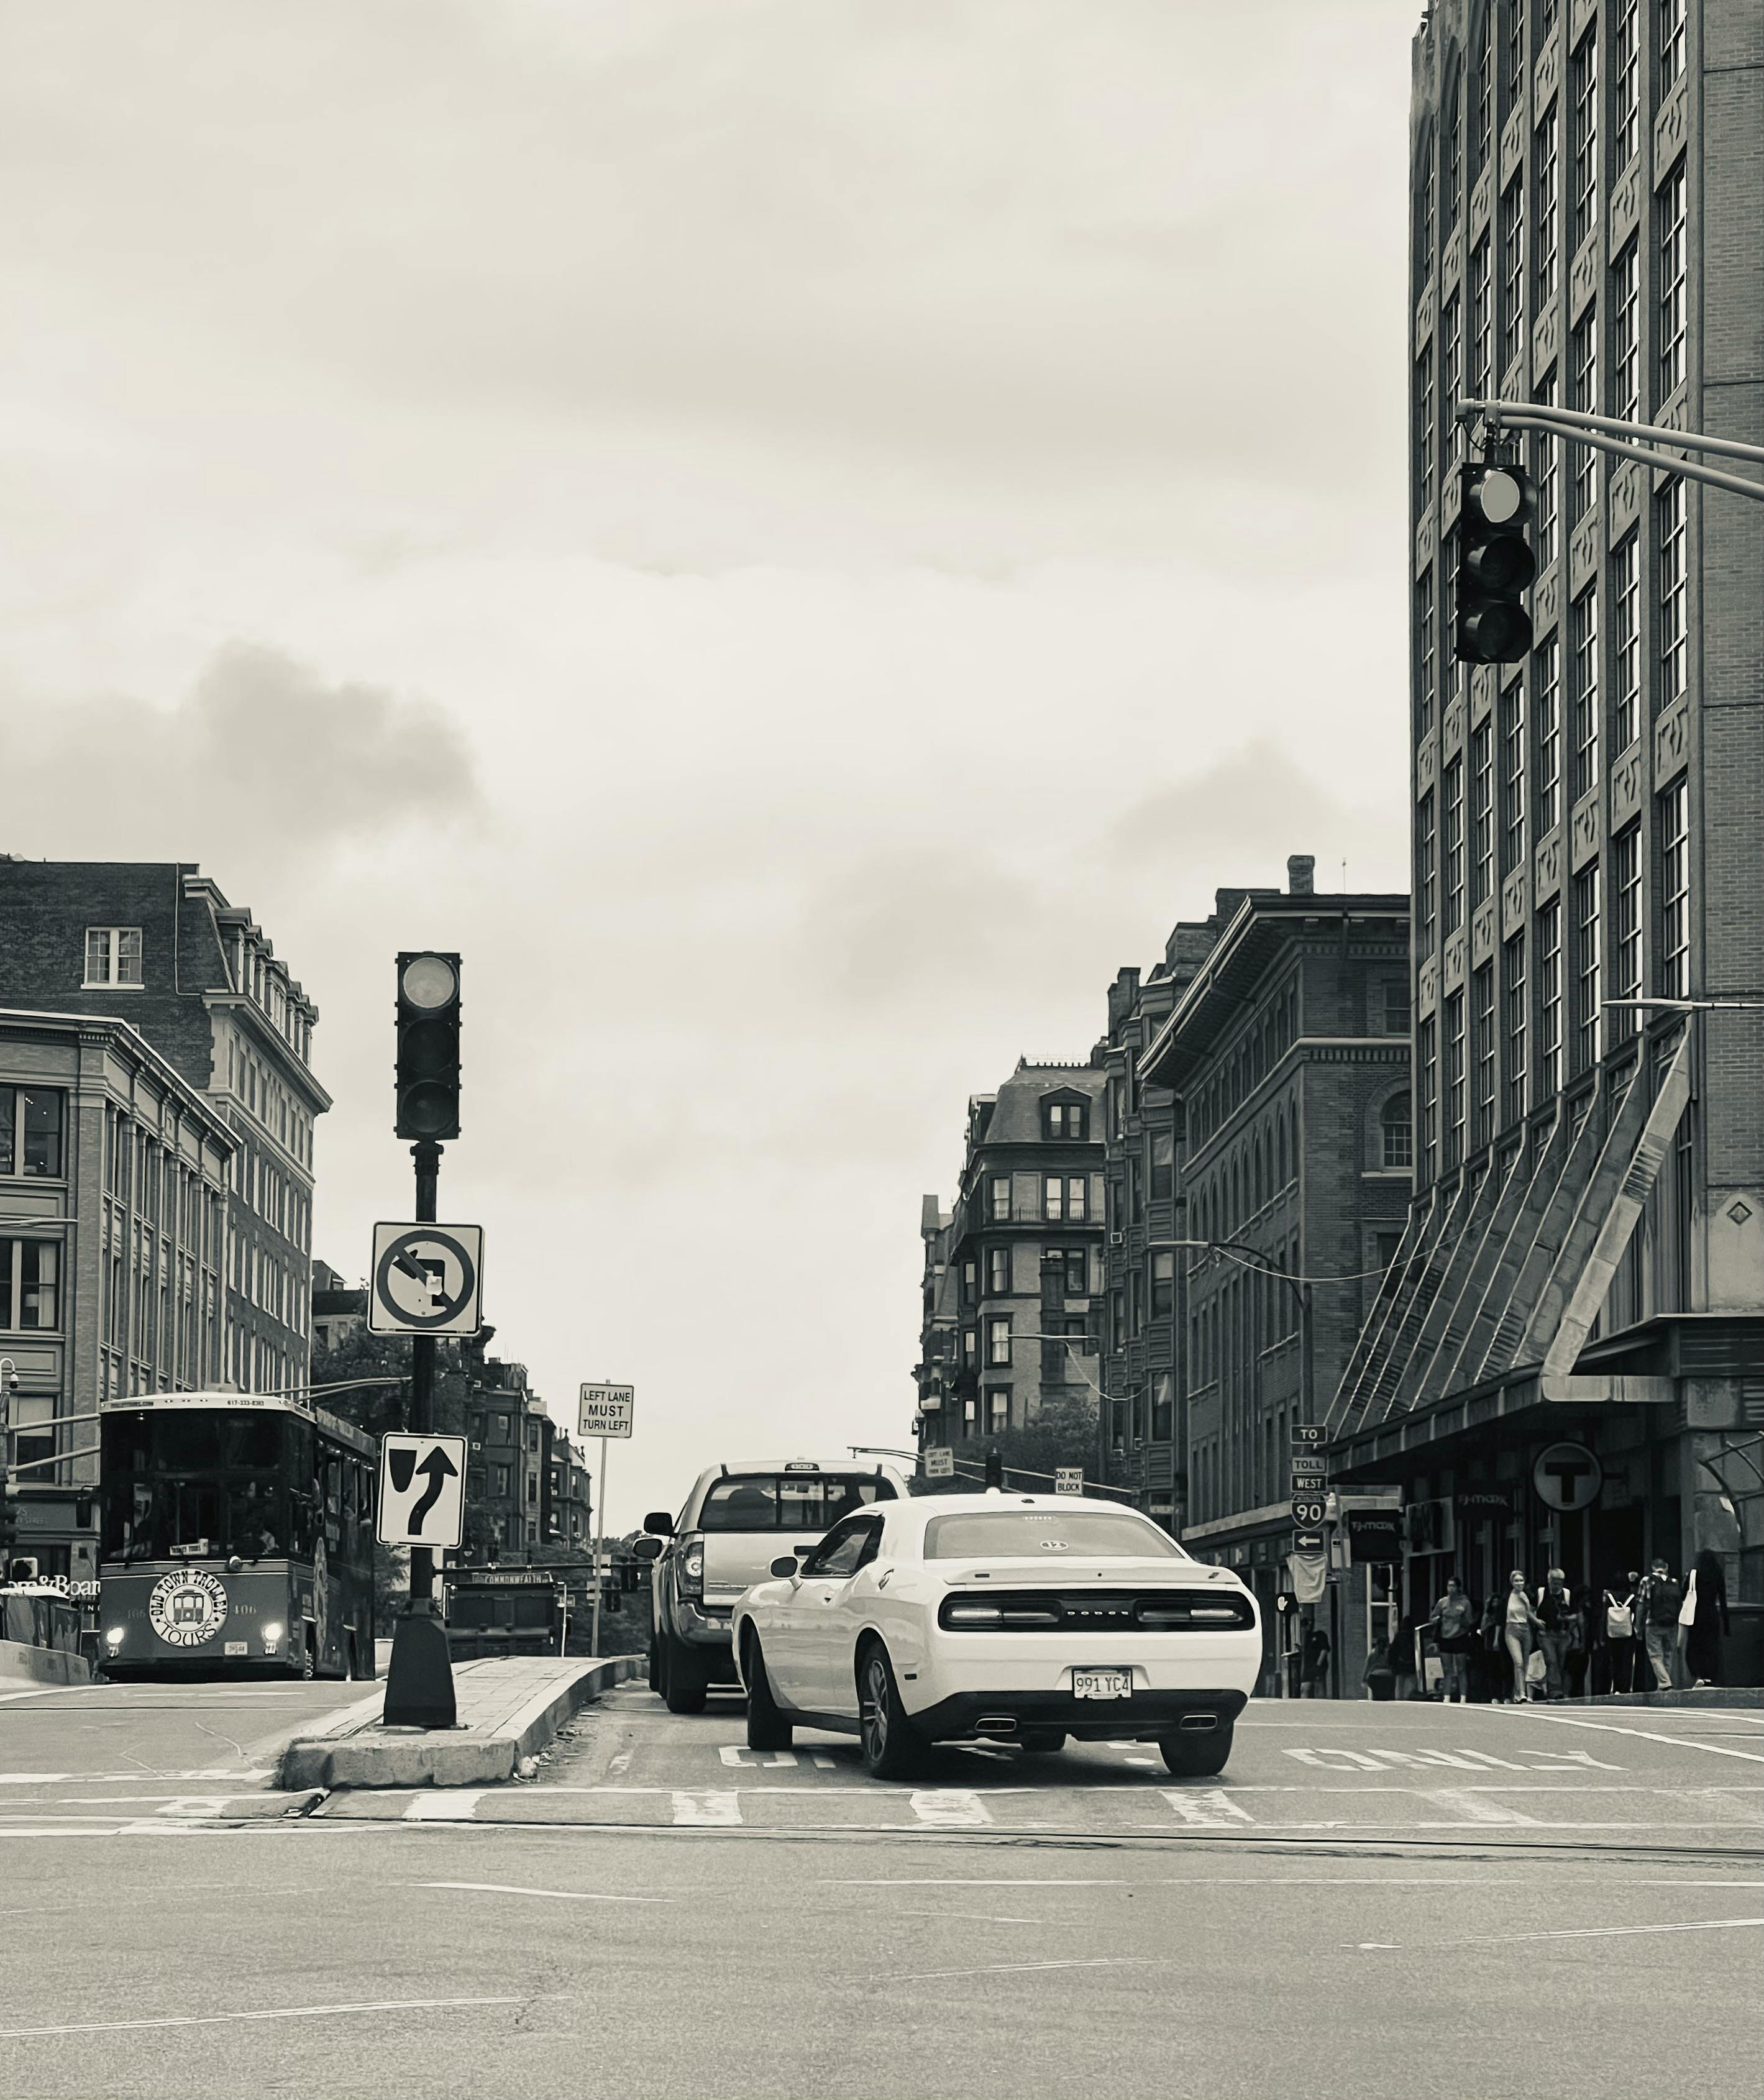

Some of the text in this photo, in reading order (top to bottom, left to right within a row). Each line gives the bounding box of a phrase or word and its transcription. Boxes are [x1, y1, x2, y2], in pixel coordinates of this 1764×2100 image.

[584, 1390, 631, 1402] LEFT LANE
[588, 1404, 624, 1417] MUST
[583, 1419, 629, 1431] TURN LEFT
[1300, 1429, 1318, 1440] TO
[1294, 1460, 1323, 1469] TOLL
[1056, 1471, 1082, 1480] DO NOT
[1058, 1482, 1080, 1491] BLOCK
[1297, 1477, 1322, 1489] WEST
[1545, 1462, 1591, 1503] T
[1297, 1504, 1321, 1520] 90
[485, 1575, 541, 1584] COMMONWEALTH
[151, 1570, 227, 1616] OLD TOWN TROLLEY
[233, 1604, 257, 1615] 406
[160, 1622, 216, 1646] TOURS
[1076, 1677, 1128, 1692] 991 YC4
[1281, 1742, 1629, 1771] ONLY
